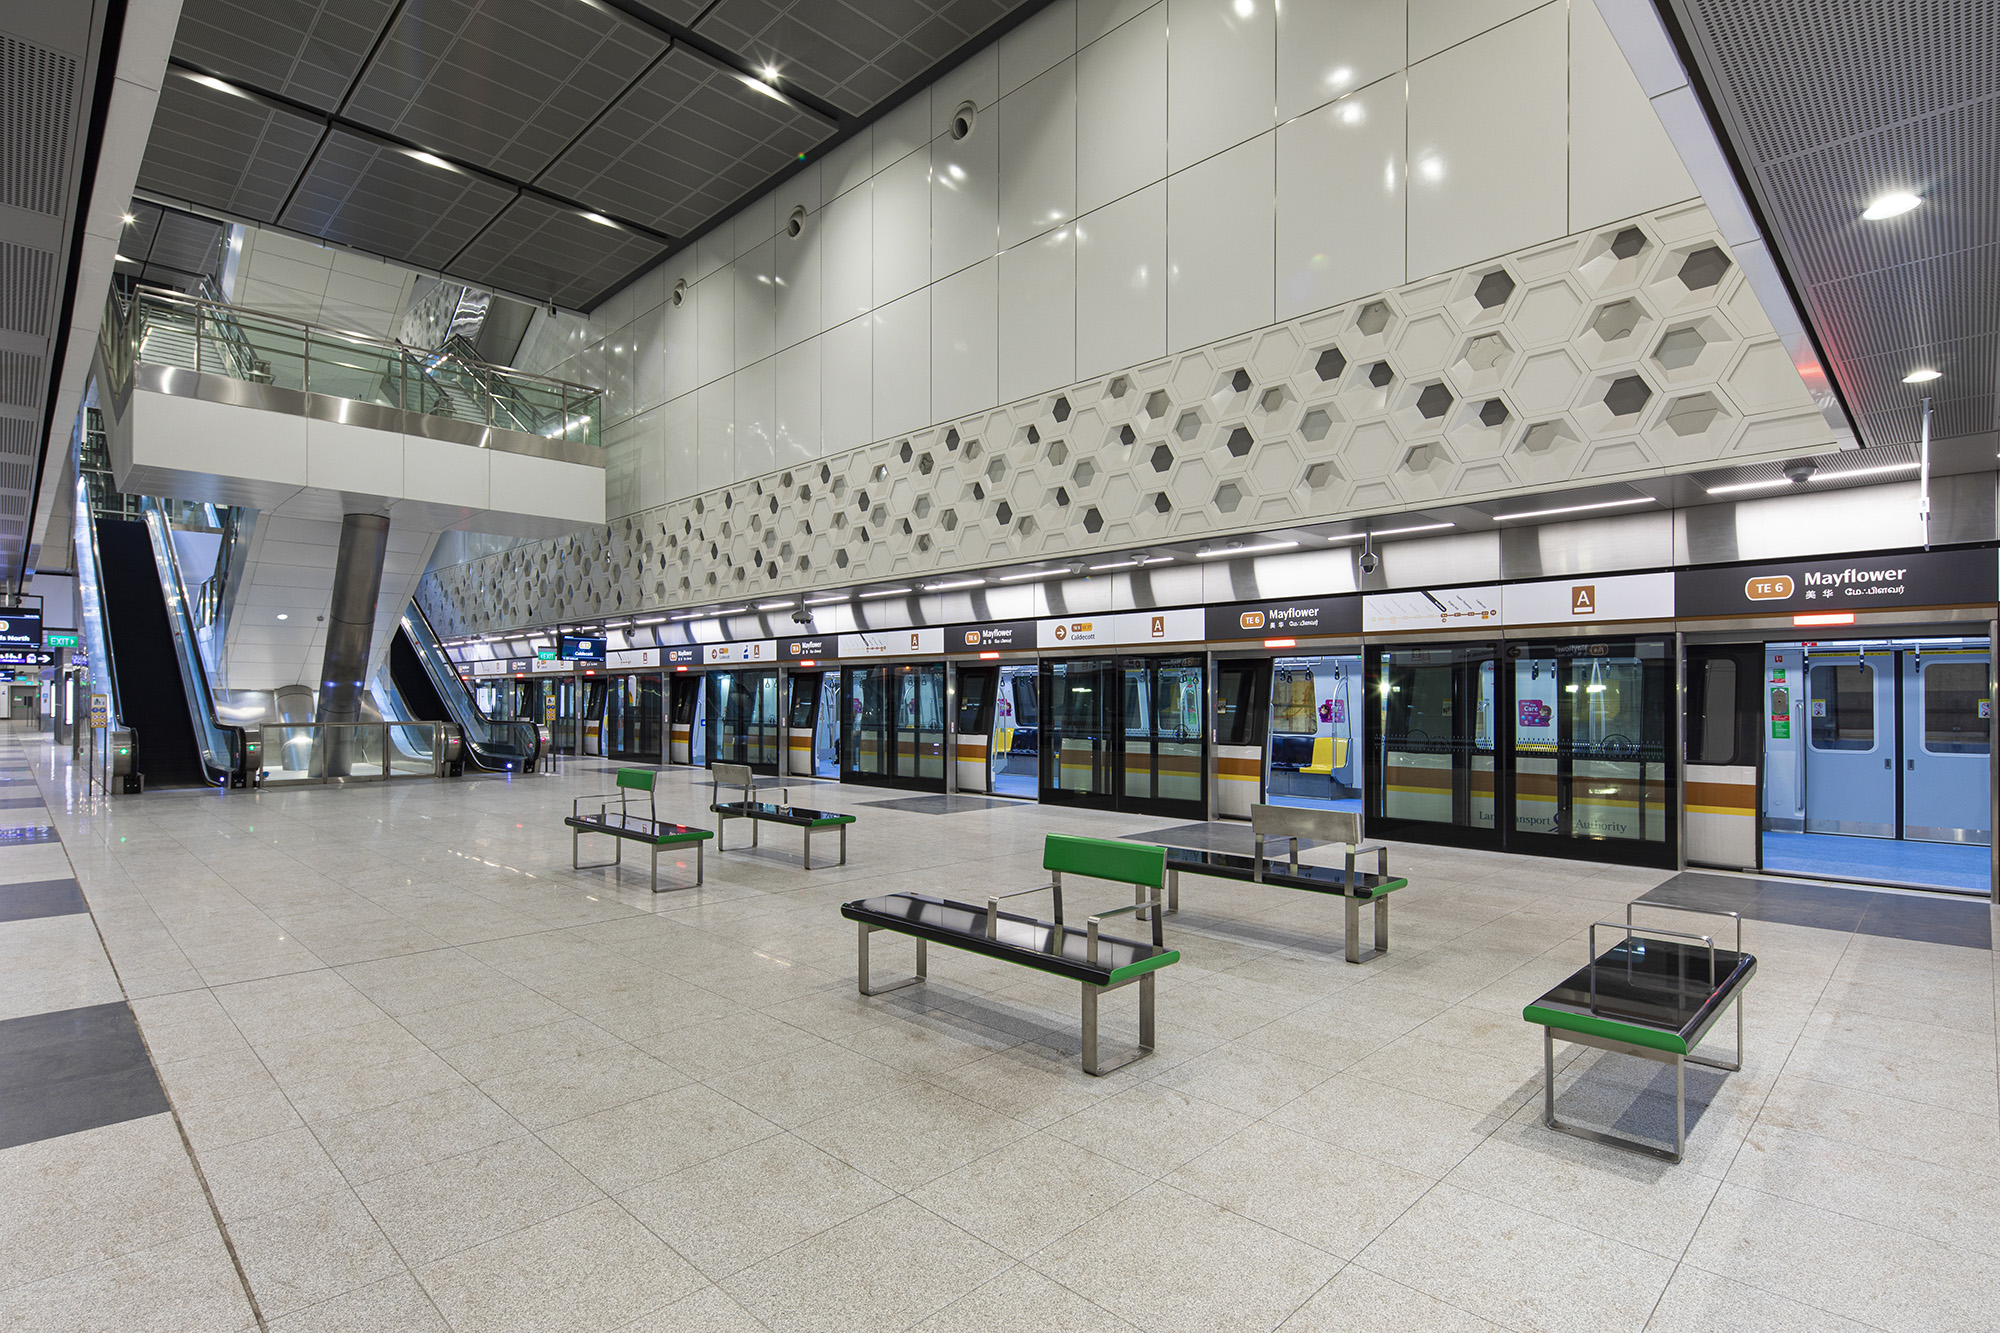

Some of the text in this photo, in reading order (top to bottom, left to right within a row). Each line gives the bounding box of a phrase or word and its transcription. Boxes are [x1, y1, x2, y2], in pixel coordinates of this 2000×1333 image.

[1804, 569, 1907, 587] Mayflower
[1756, 582, 1784, 594] TE 6
[1577, 590, 1590, 606] A
[1269, 607, 1319, 620] Mayflower
[1153, 619, 1162, 631] A
[1255, 616, 1260, 624] 6
[982, 629, 1012, 638] Mayflower
[1071, 633, 1095, 641] Caldecott
[50, 637, 69, 645] EXIT
[912, 636, 918, 645] A
